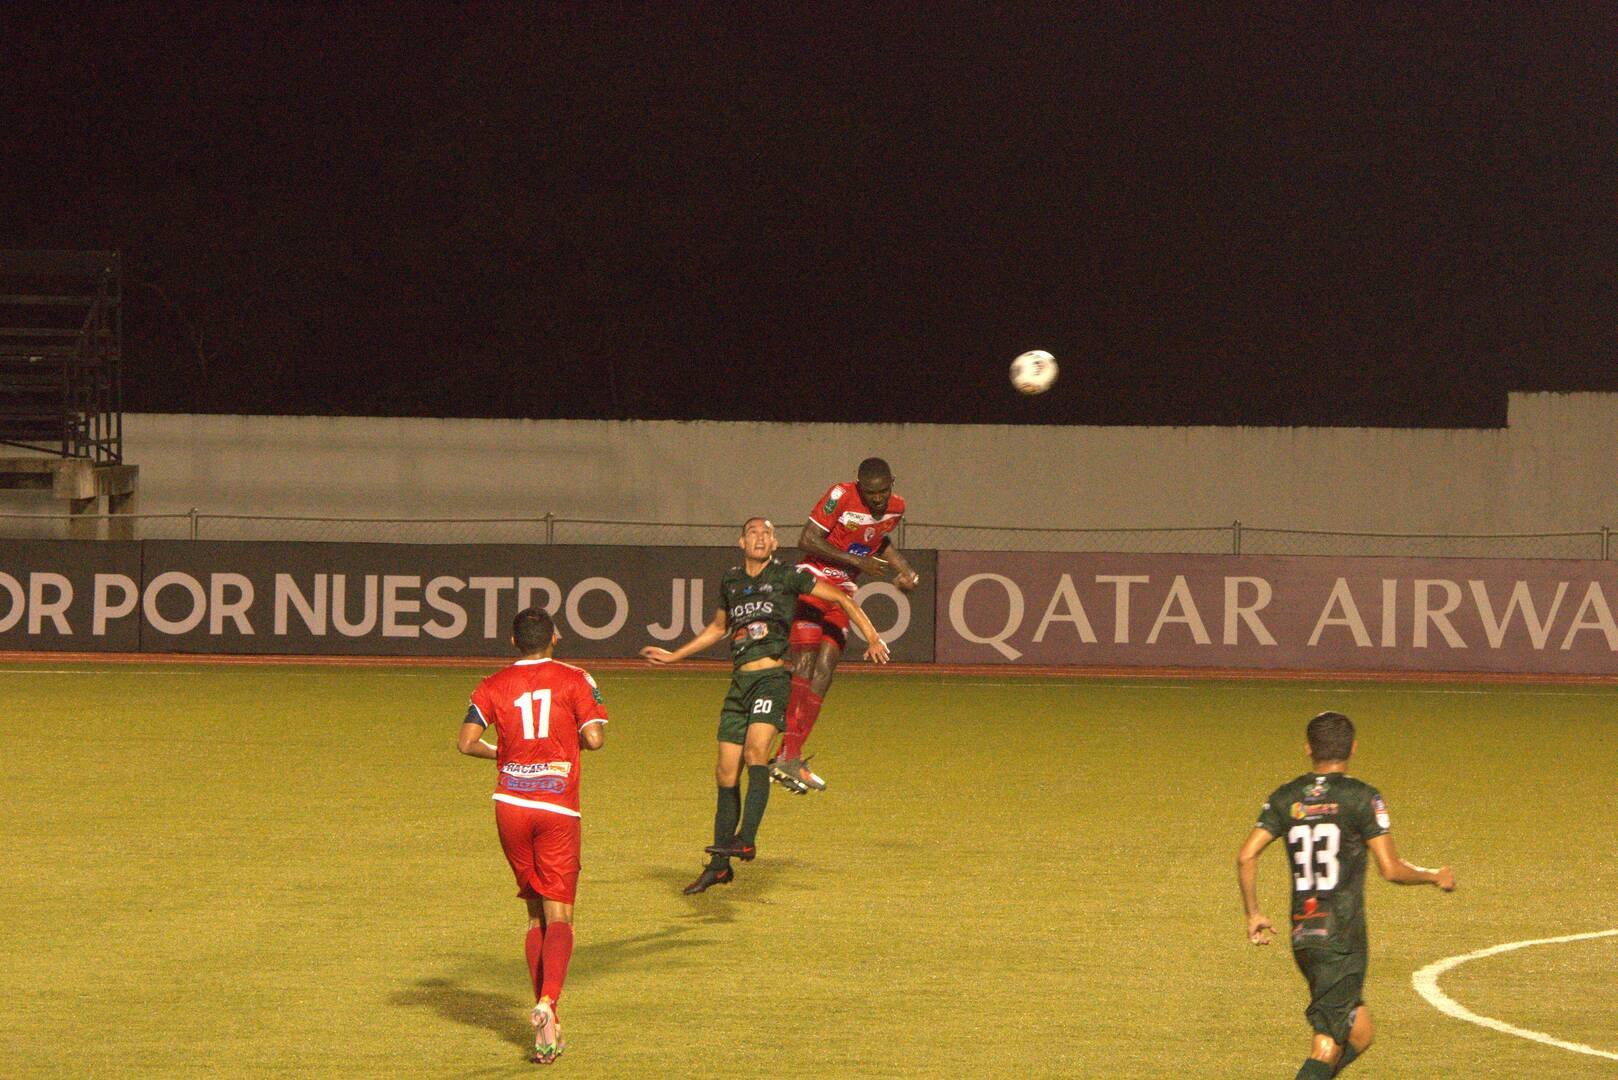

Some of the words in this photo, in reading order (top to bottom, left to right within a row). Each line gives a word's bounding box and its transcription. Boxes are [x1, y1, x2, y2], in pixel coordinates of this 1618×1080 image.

[93, 571, 256, 636] POR
[274, 573, 629, 640] NUESTRO
[948, 573, 1279, 661] QATAR
[1307, 577, 1618, 652] AIRWA
[513, 688, 552, 740] 17
[753, 698, 773, 714] 20
[1288, 823, 1341, 891] 33
